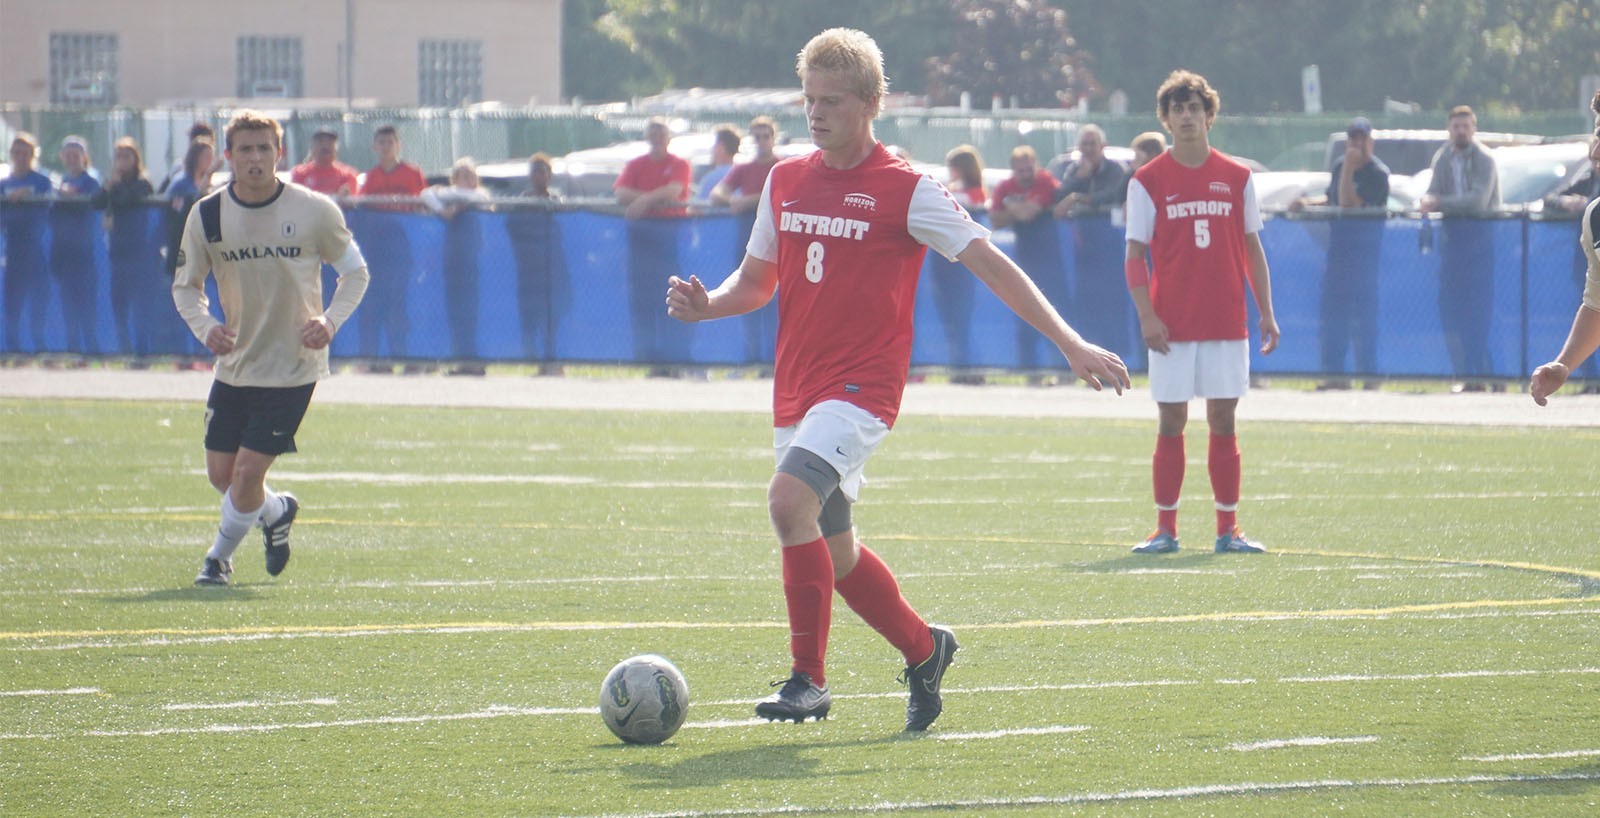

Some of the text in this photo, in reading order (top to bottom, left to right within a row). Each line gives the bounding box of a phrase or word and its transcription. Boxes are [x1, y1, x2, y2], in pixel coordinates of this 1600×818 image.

[844, 196, 875, 207] HORIZON
[1166, 200, 1233, 219] DETROIT
[780, 211, 870, 240] DETROIT
[1194, 219, 1211, 248] 5
[221, 246, 302, 261] OAKLAND
[805, 241, 825, 283] 8
